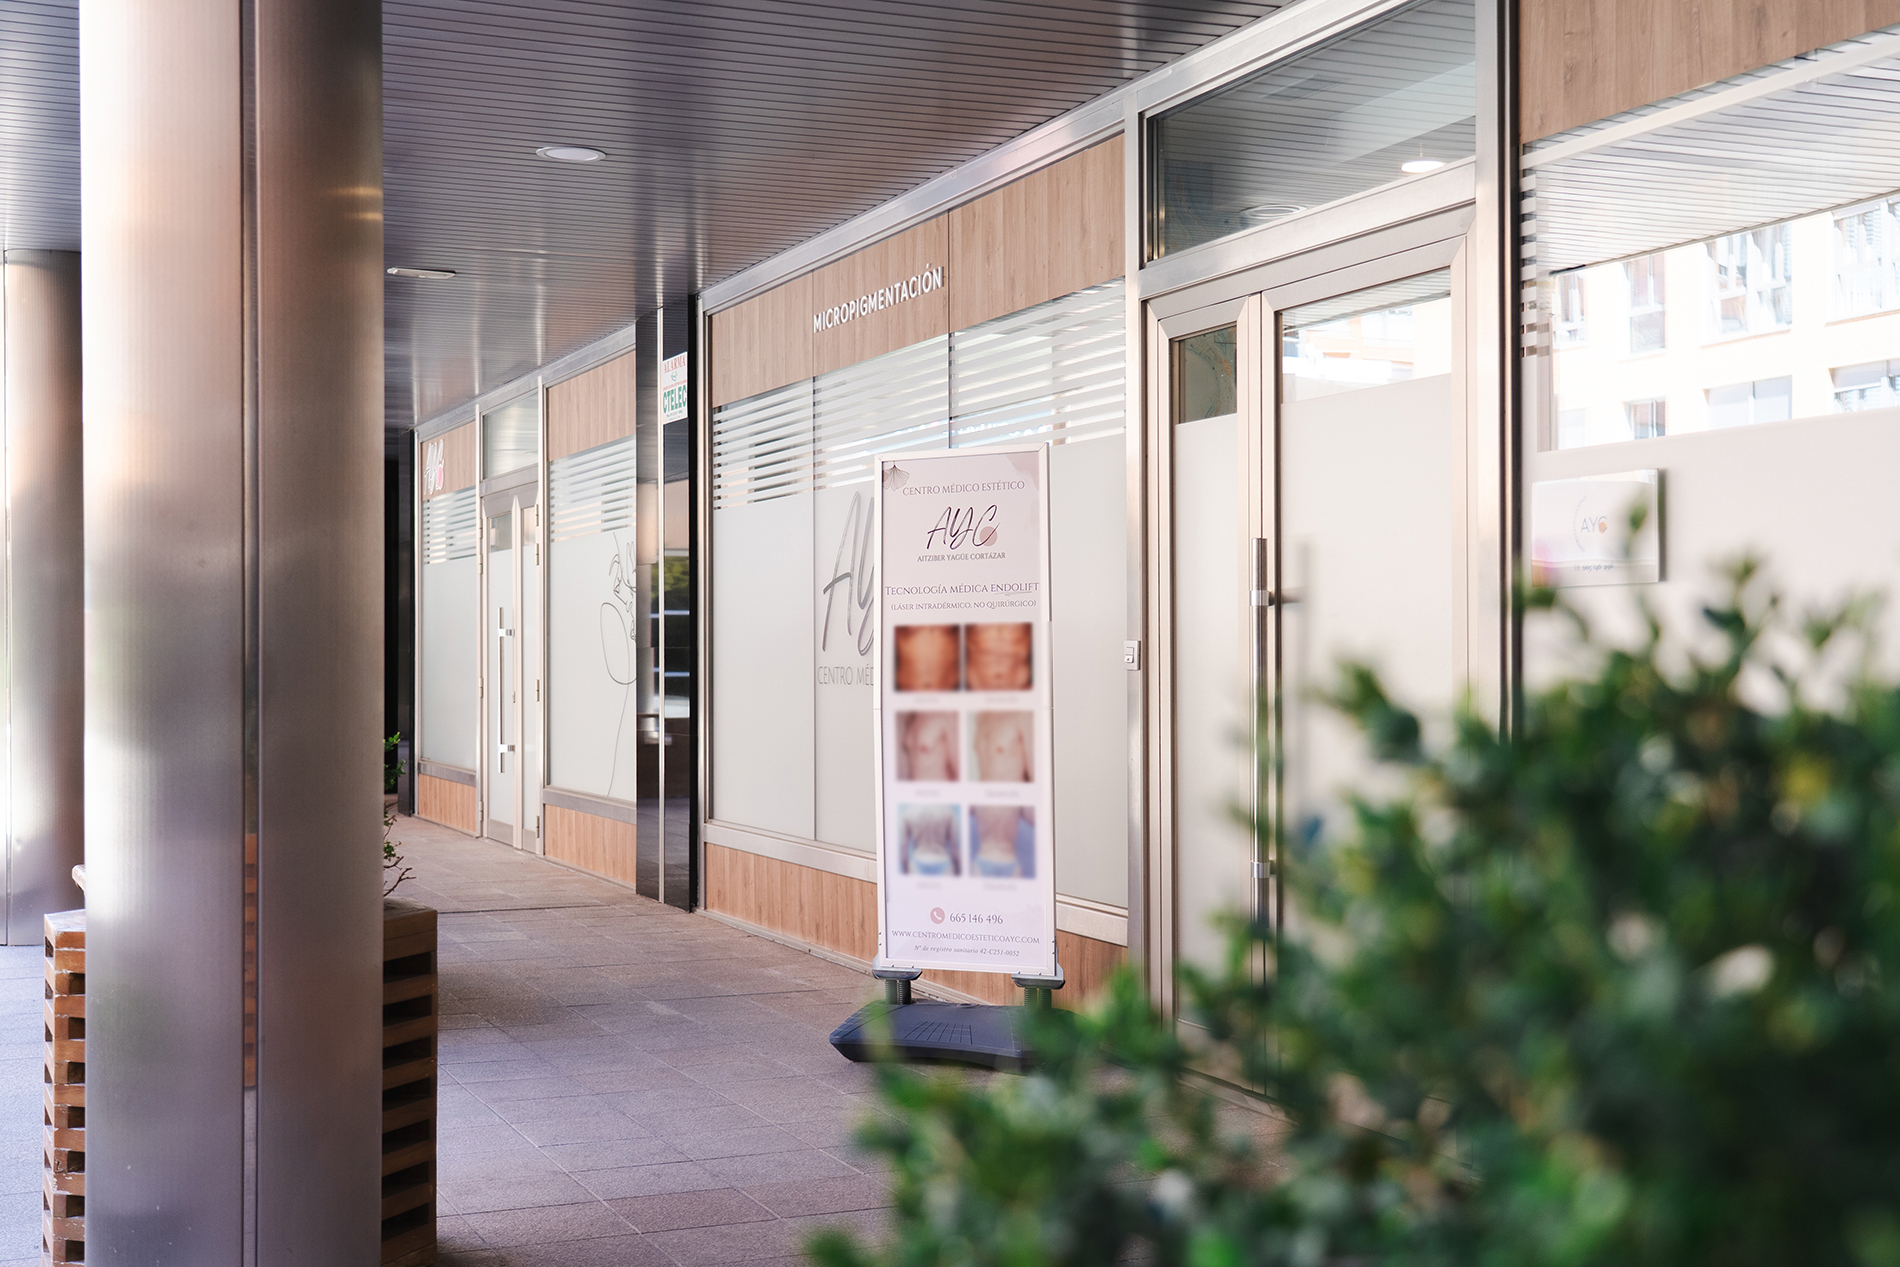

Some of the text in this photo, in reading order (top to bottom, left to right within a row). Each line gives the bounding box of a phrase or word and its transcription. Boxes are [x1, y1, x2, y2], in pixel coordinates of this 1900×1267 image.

[813, 263, 943, 333] MICROPIGMENTACIÓN
[664, 355, 686, 374] ALARMA
[663, 385, 687, 413] CTELEC
[902, 480, 1026, 496] CENTRO MÉDICO ESTÉTICO
[926, 504, 1001, 550] AYC
[1580, 515, 1608, 533] AYC
[917, 551, 1006, 563] AITZIBER YAGÜE CORTÁZAR
[885, 581, 1040, 596] TECNOLOGÍA MÉDICA ENDOLIFT
[891, 601, 914, 611] (LÁSER
[973, 601, 986, 609] NO
[986, 599, 1037, 610] QUIRÚRGICO)
[817, 665, 853, 685] CENTRO
[949, 912, 1004, 925] 665 146 496
[891, 930, 1040, 944] WWW.CENTROMEDICOESTETICOAYC.COM
